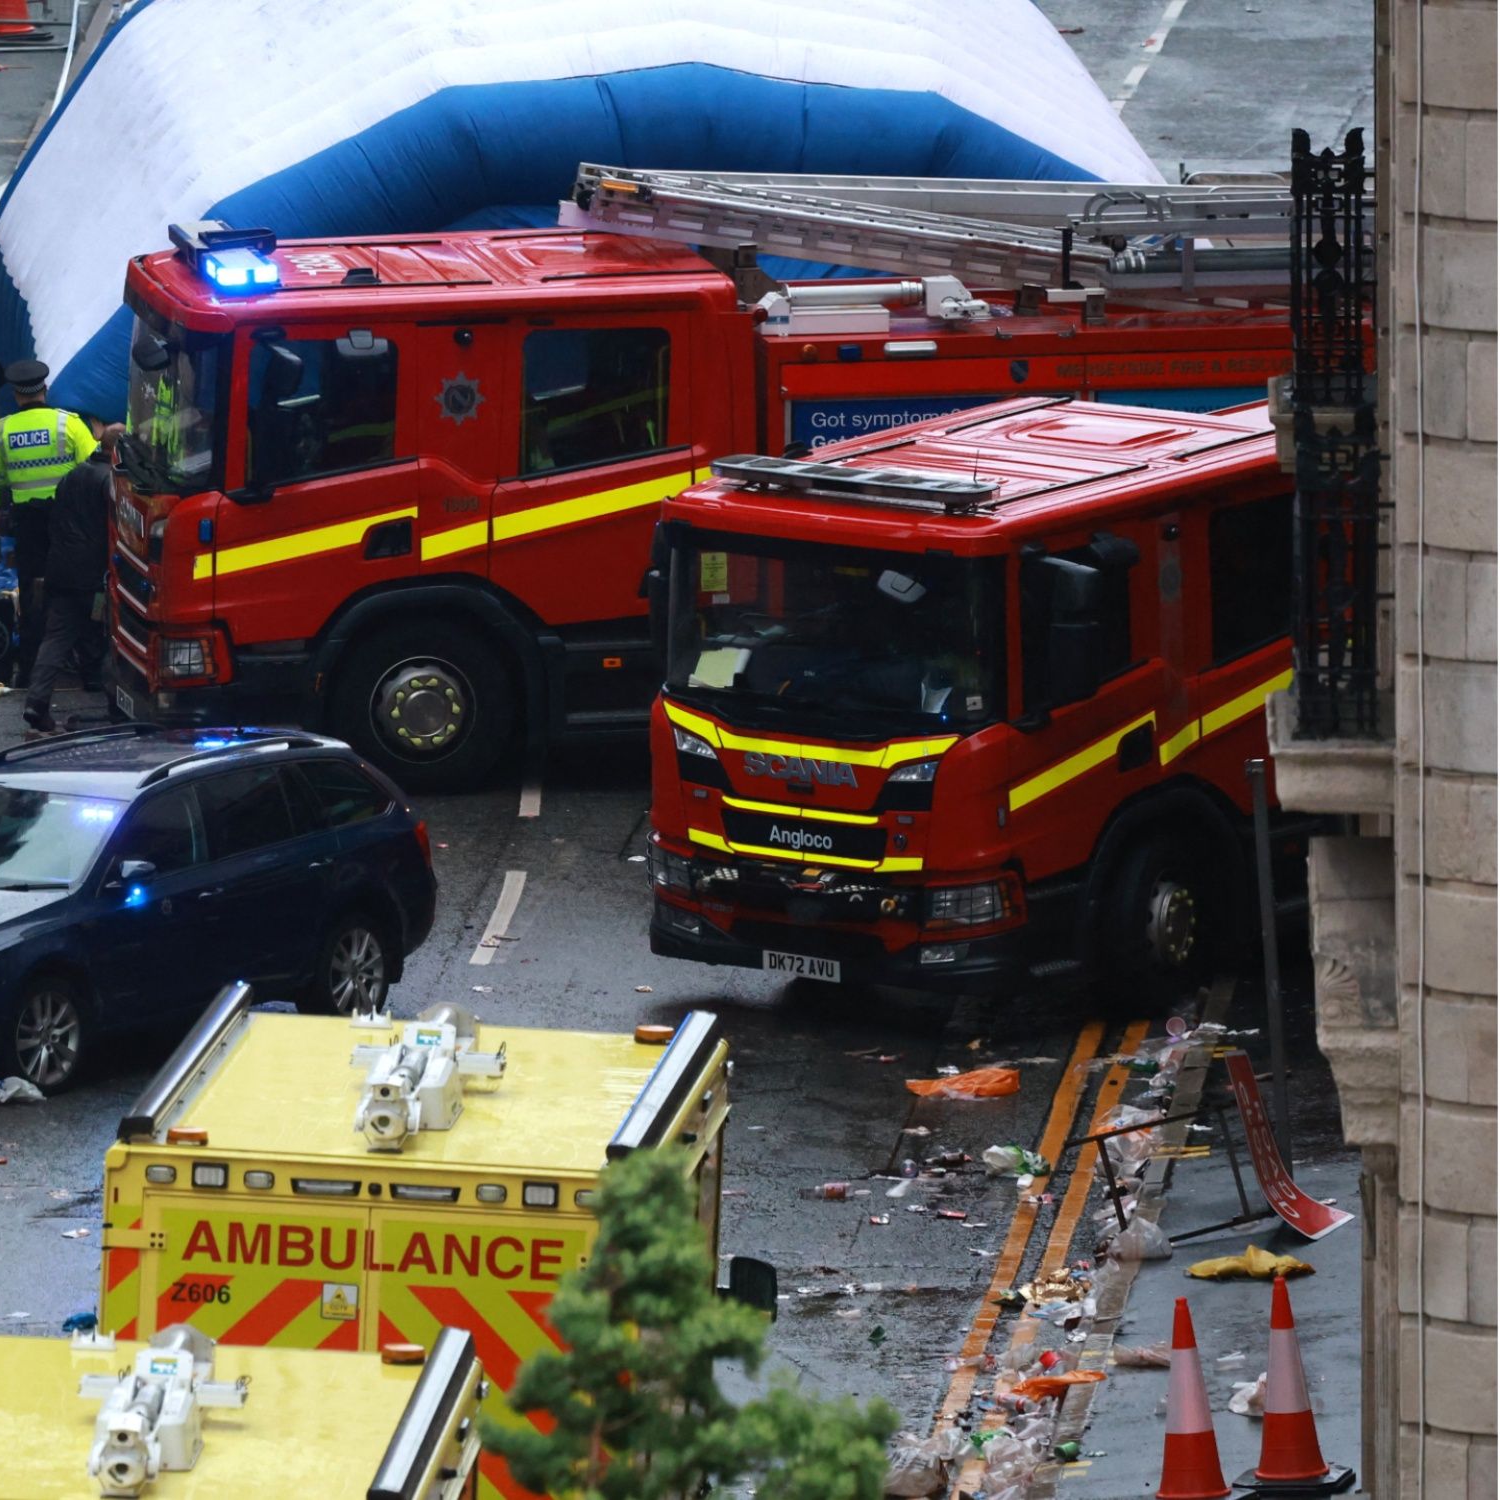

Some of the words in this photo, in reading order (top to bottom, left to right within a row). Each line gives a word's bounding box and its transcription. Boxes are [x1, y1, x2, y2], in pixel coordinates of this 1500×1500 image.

[811, 412, 846, 427] Got
[10, 430, 48, 447] POLICE
[744, 751, 858, 788] SCANIA
[769, 824, 833, 850] Angloco
[769, 952, 804, 974] DK72
[808, 959, 835, 978] AVU
[181, 1219, 565, 1281] AMBULANCE
[171, 1281, 231, 1305] Z606
